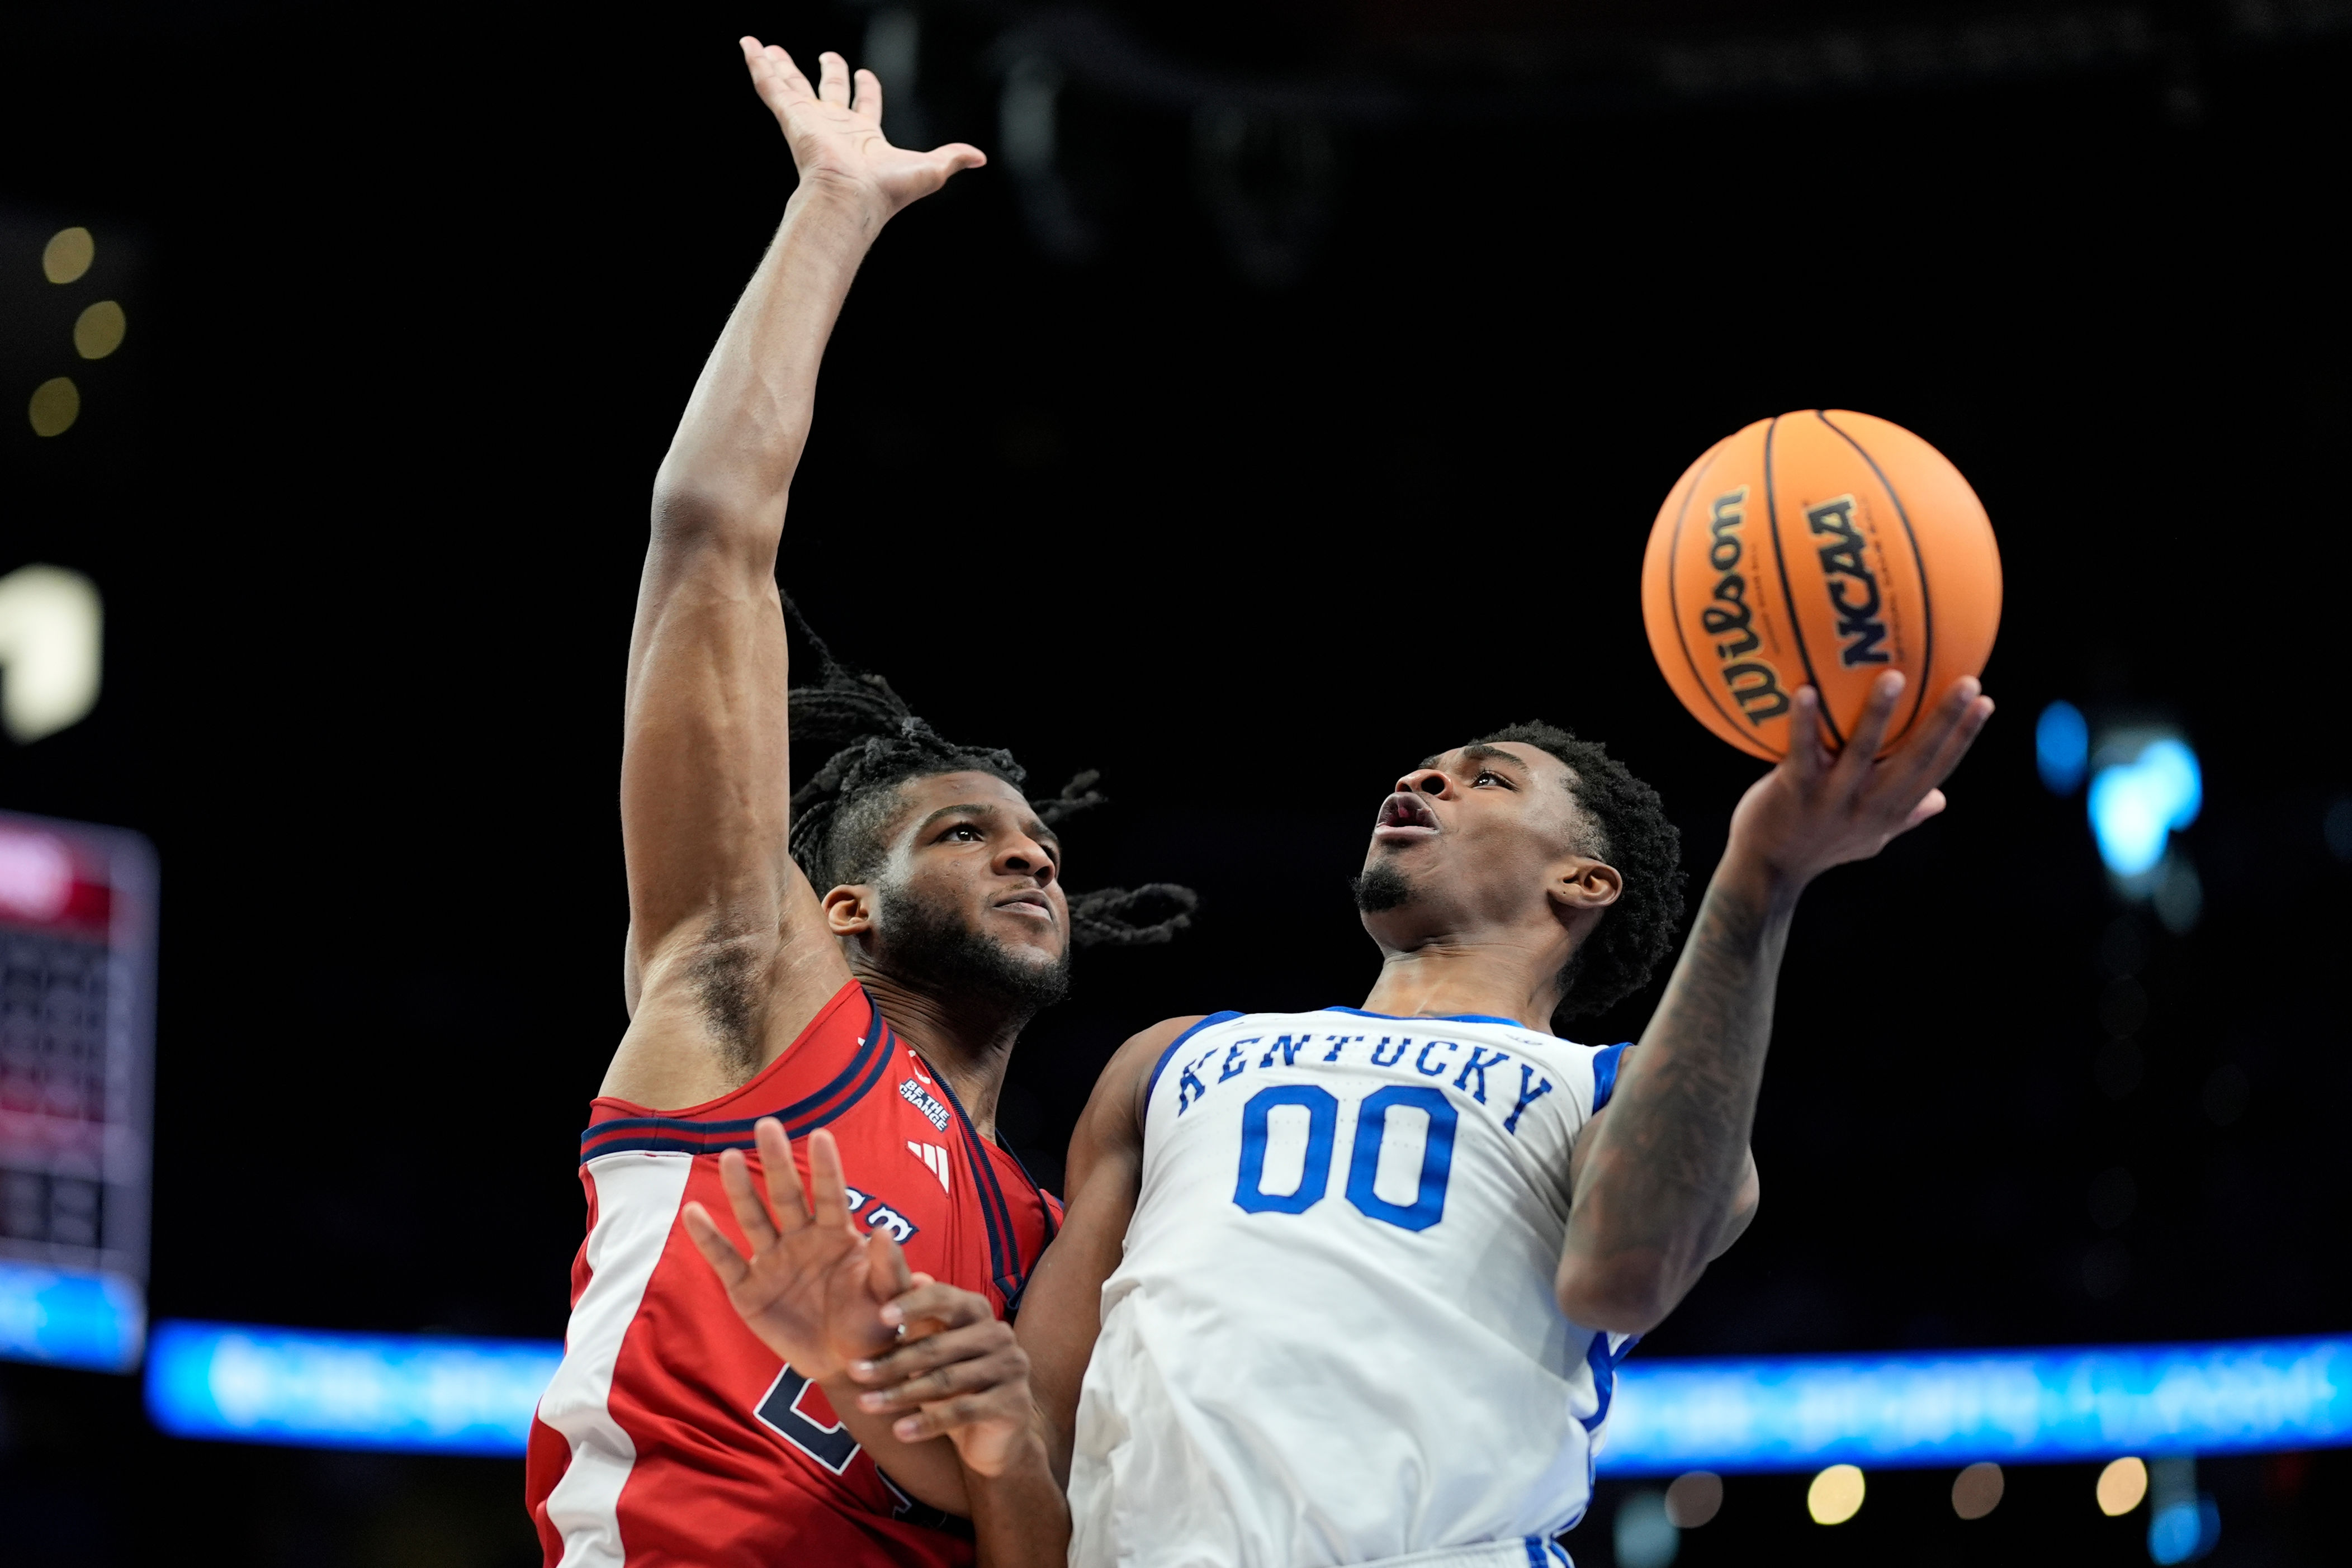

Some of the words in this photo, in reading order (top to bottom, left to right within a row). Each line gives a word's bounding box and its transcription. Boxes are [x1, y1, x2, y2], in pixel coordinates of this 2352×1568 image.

[1701, 485, 1790, 727] Wilson
[1806, 493, 1891, 669] NCAA
[899, 1084, 948, 1132] CHANGE
[904, 1079, 926, 1098] BE
[925, 1095, 950, 1122] THE
[1178, 1034, 1553, 1135] KENTUCKY
[1232, 1084, 1459, 1232] 00
